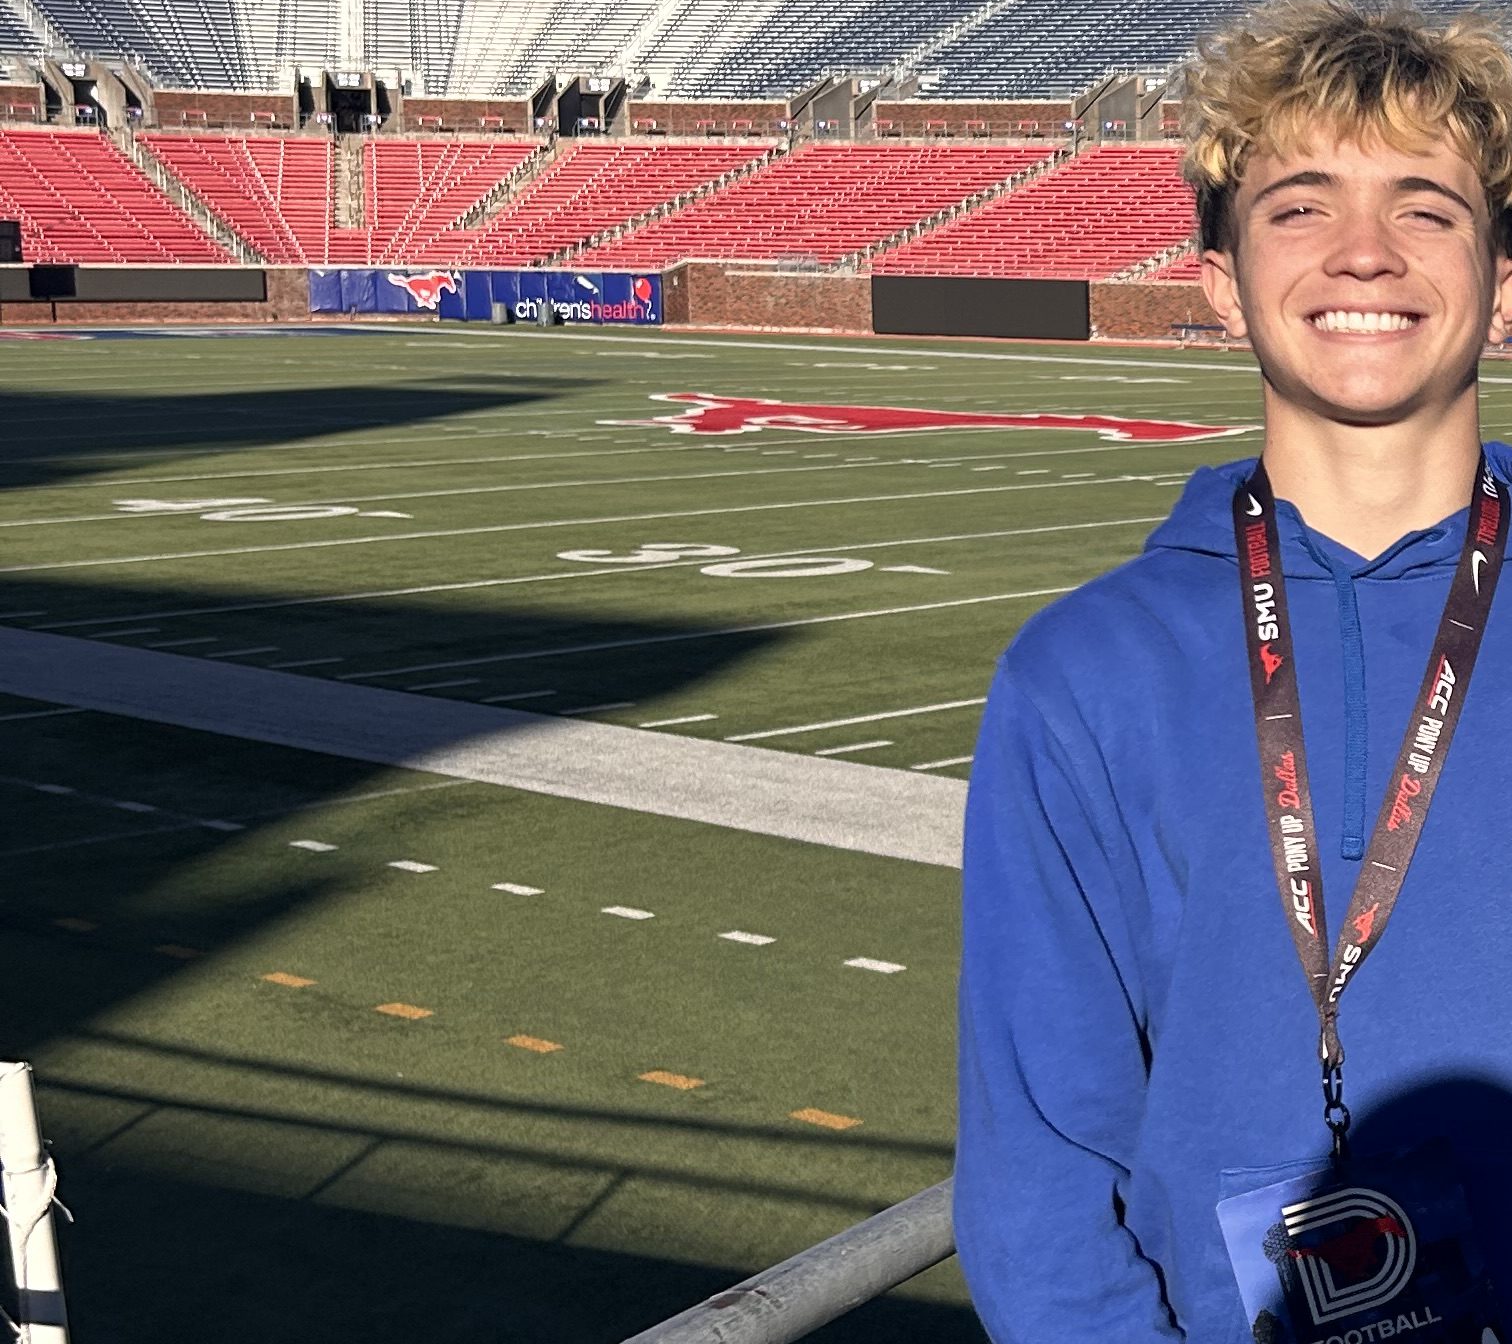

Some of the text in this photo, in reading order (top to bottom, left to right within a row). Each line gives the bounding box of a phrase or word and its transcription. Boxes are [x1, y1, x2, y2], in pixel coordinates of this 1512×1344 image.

[556, 543, 874, 578] 30
[1253, 582, 1279, 641] SMU
[1431, 658, 1456, 716] ACC
[1414, 716, 1443, 755] PONY
[1408, 753, 1432, 774] UP
[1274, 750, 1316, 936] ACC PONY UP Dallas
